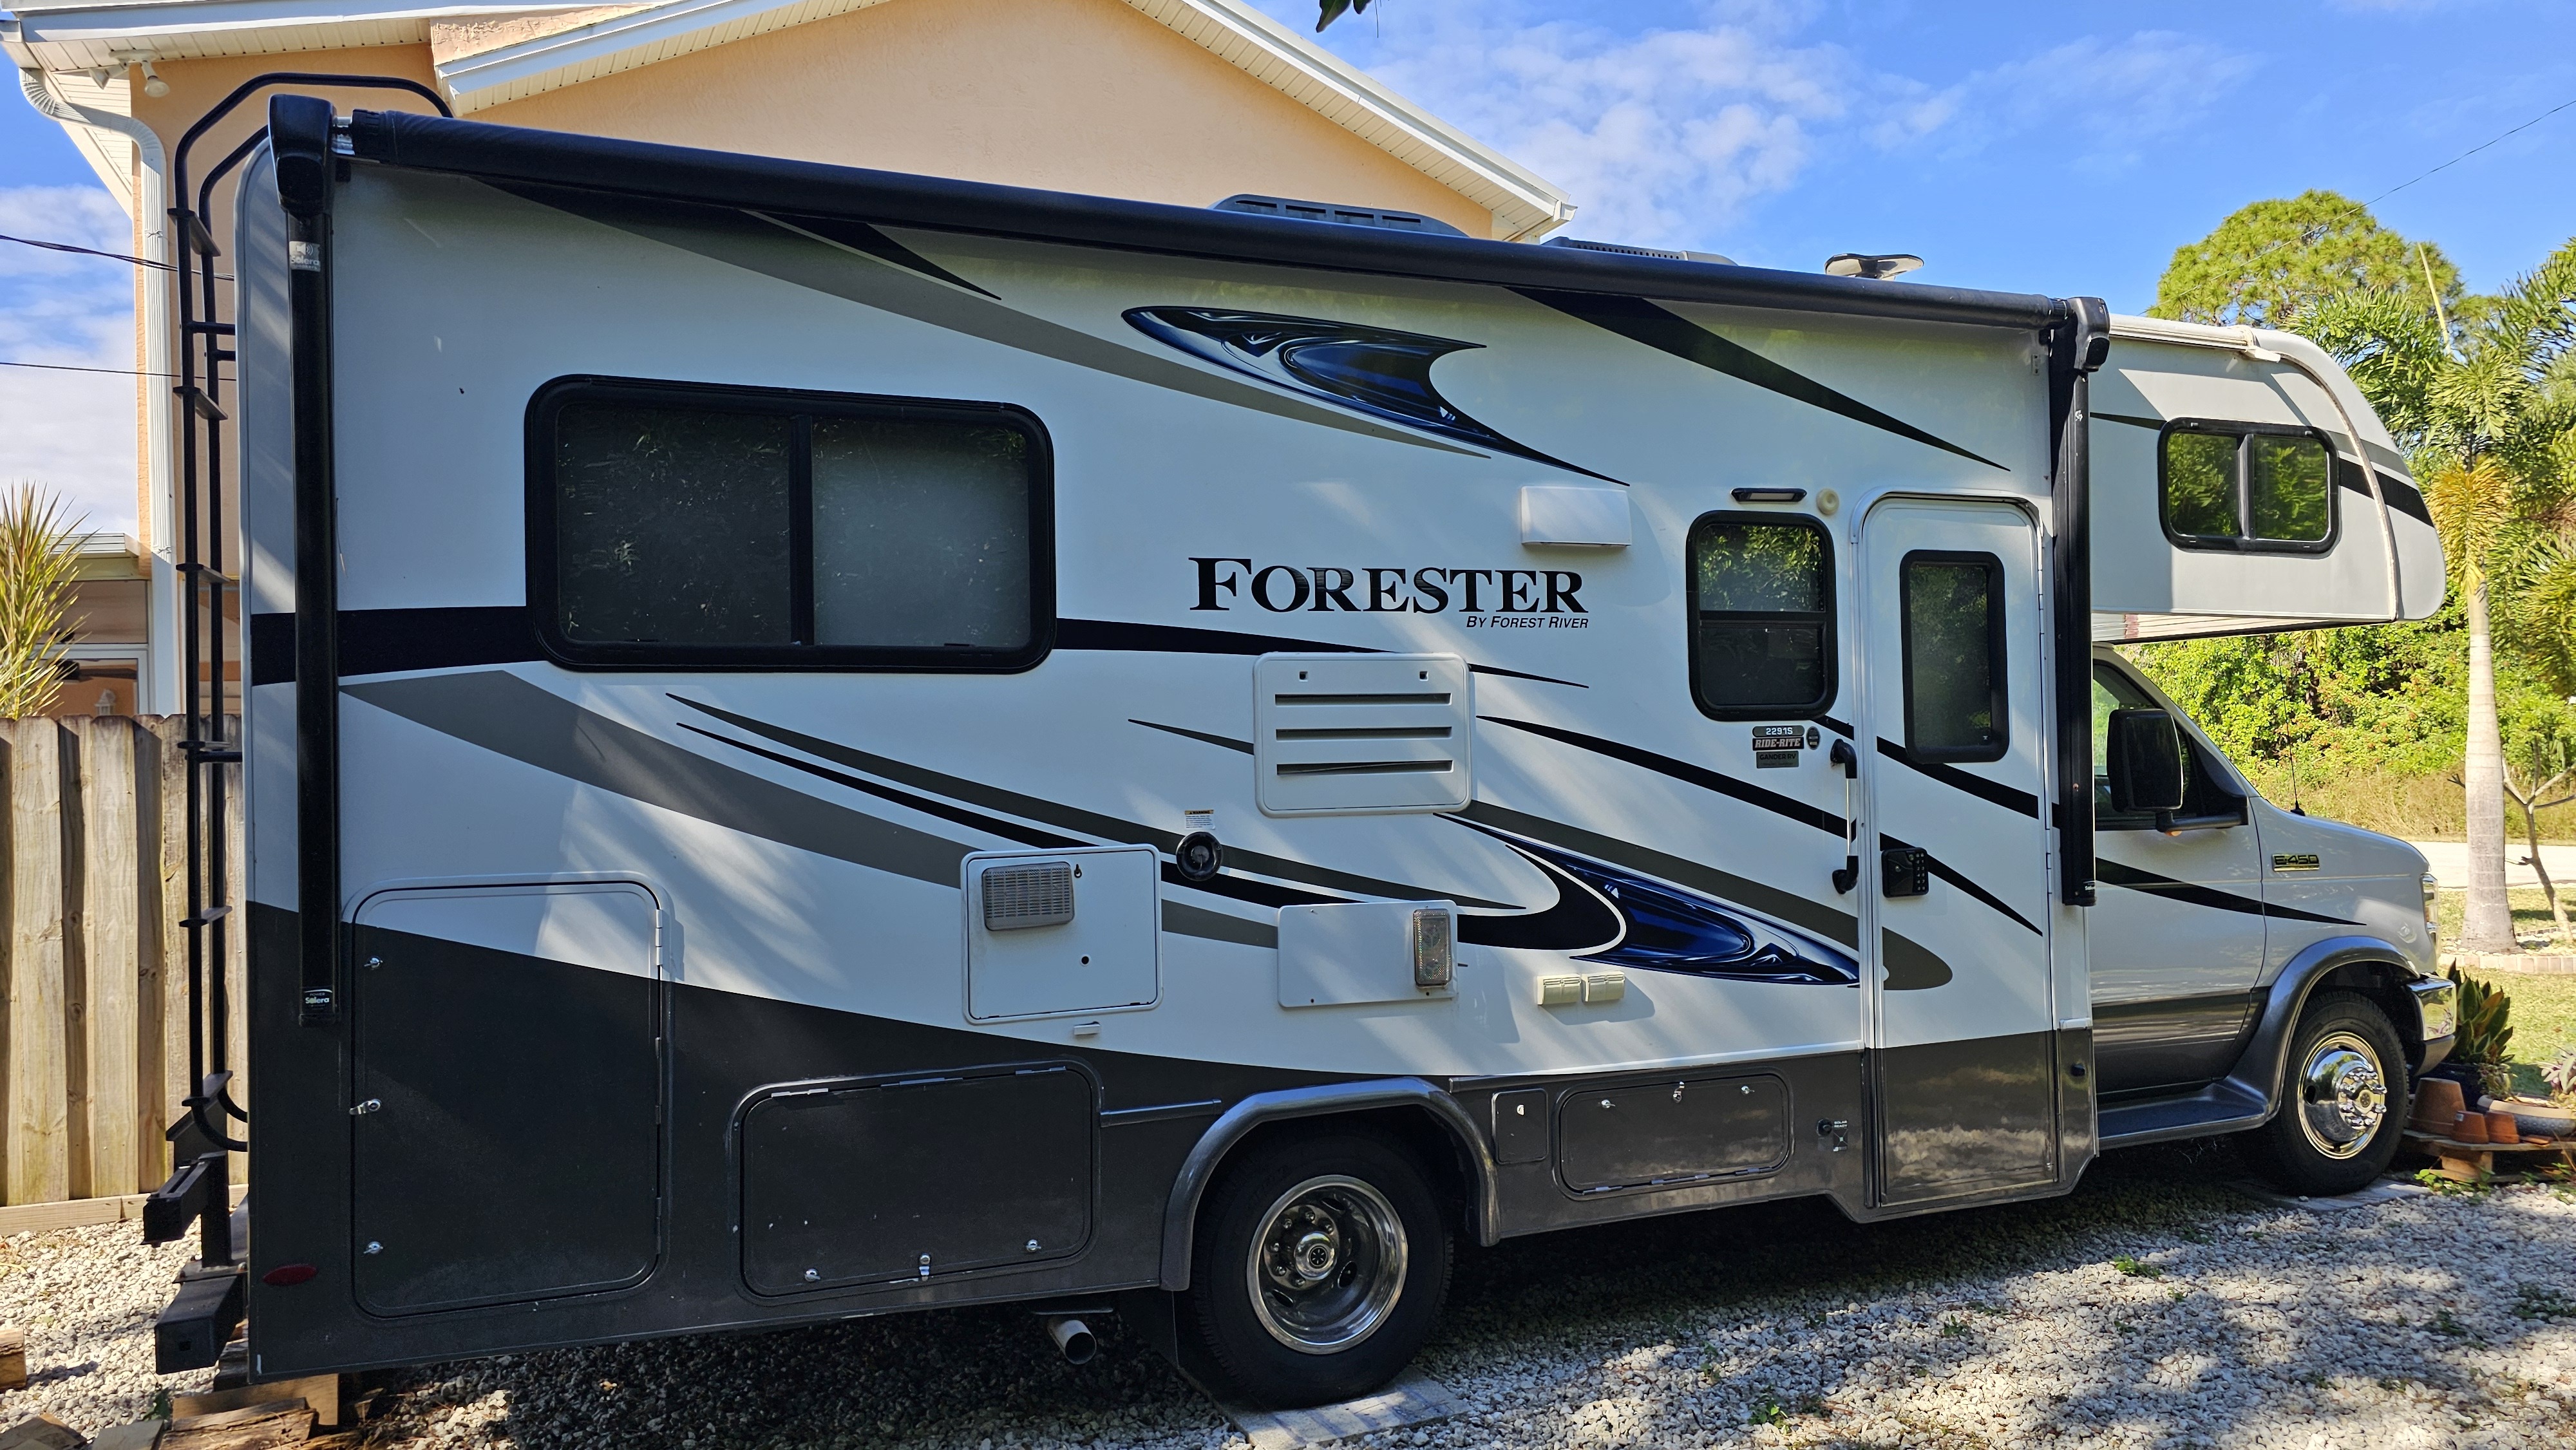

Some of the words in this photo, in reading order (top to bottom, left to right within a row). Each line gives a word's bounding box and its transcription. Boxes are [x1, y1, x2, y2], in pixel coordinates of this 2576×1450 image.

[1188, 557, 1589, 614] FORESTER
[1491, 616, 1545, 628] FOREST
[1549, 616, 1589, 628] RIVER
[1755, 738, 1801, 748] RIDE-RITE
